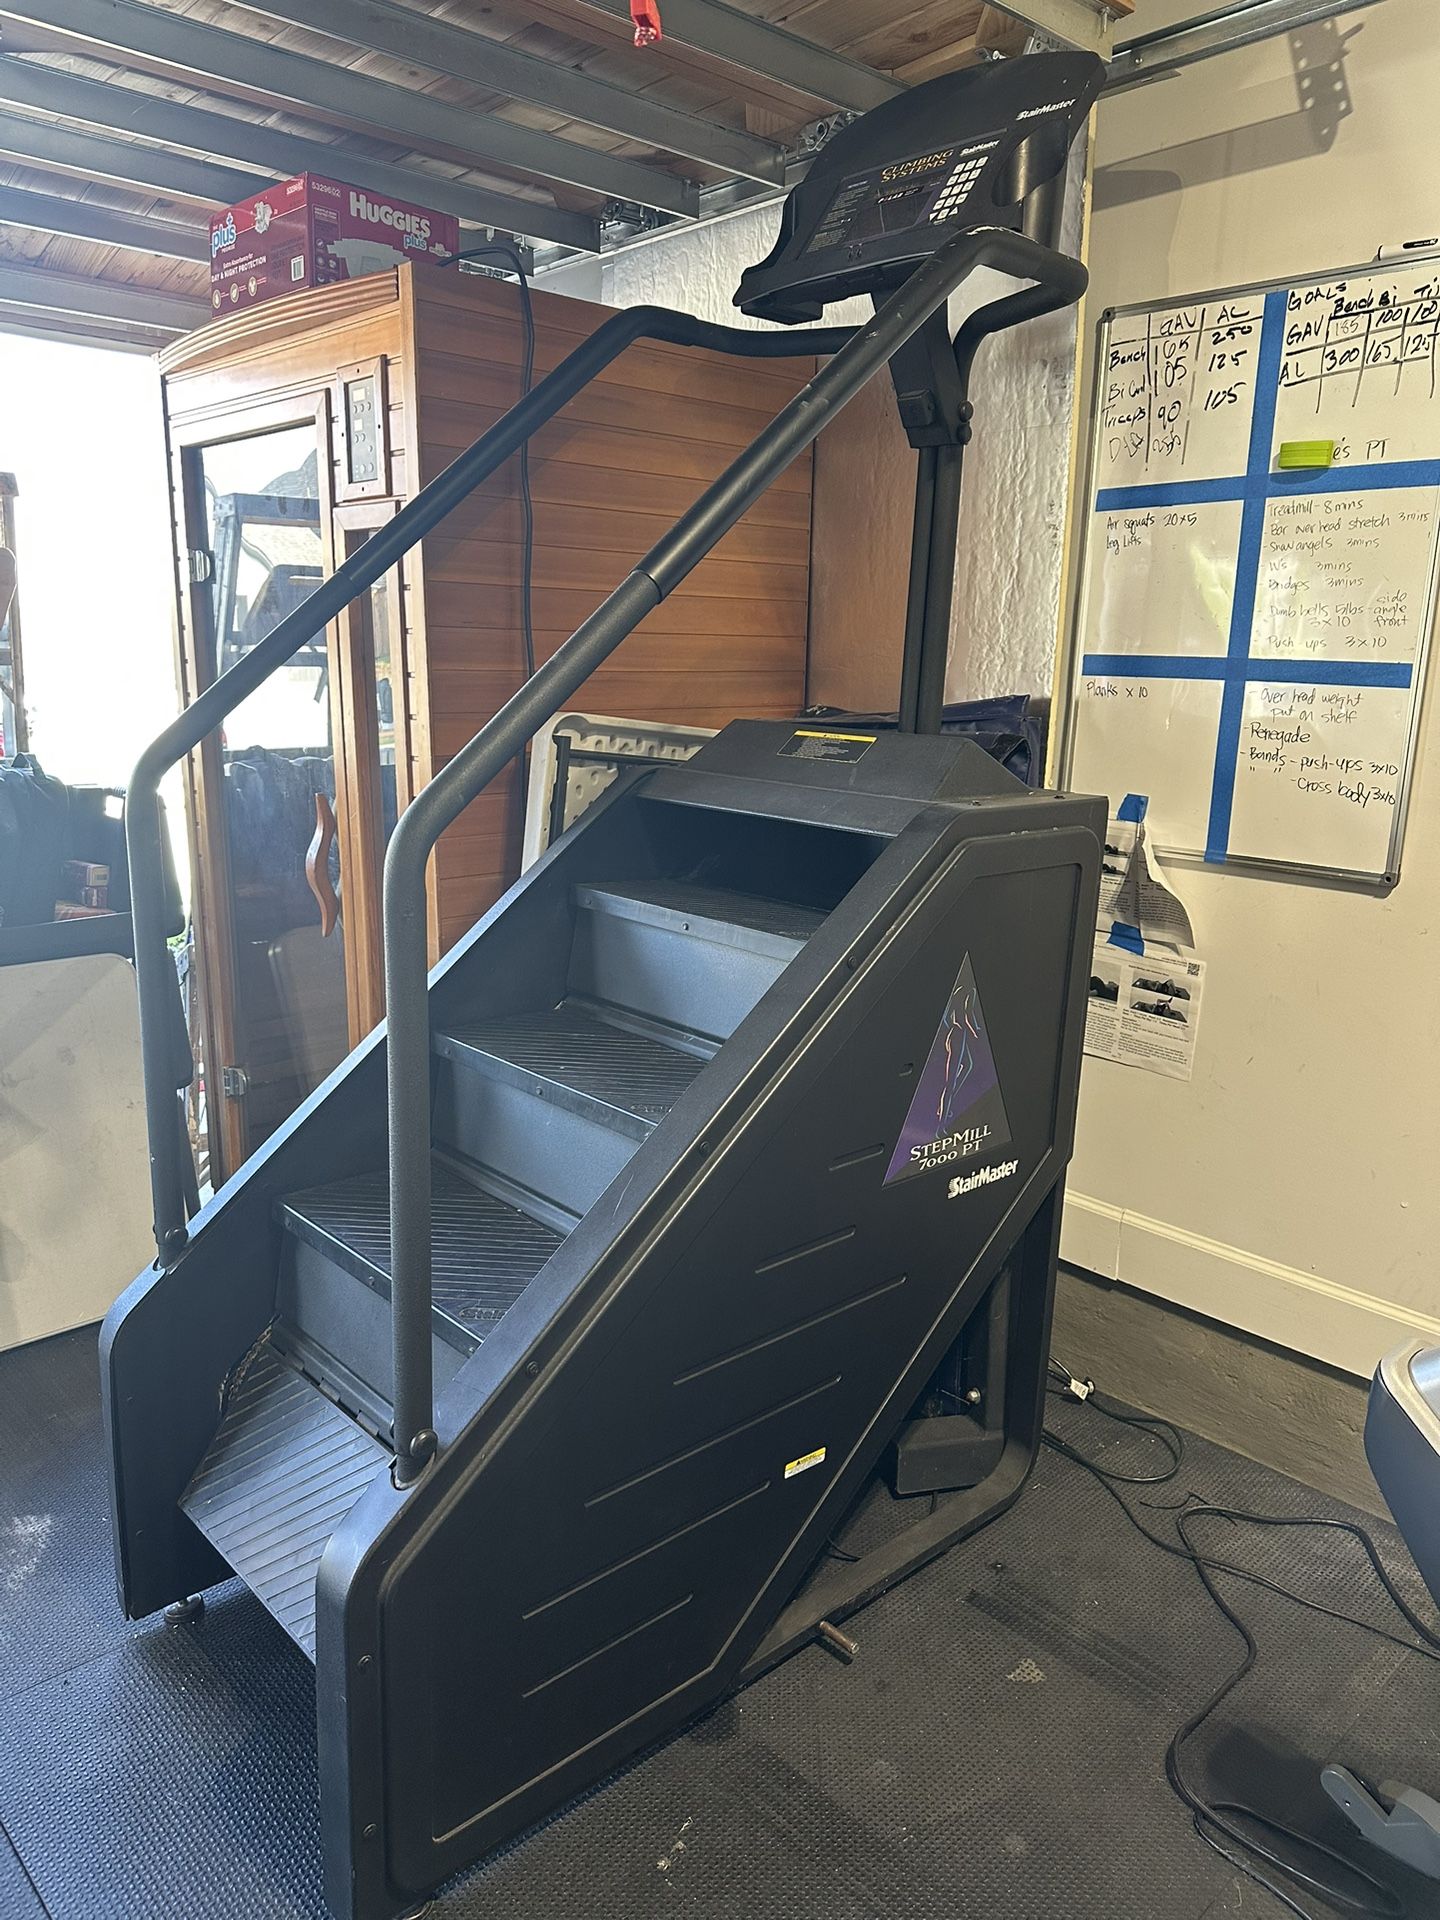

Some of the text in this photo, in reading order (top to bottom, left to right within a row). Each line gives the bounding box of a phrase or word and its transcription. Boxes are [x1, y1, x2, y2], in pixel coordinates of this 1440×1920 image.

[1016, 99, 1076, 121] StairMaster
[881, 158, 947, 183] SYSTEMS
[882, 149, 954, 176] CLIMBING
[212, 219, 236, 258] plus
[404, 234, 427, 251] plus
[239, 255, 267, 273] PROTECTION
[1287, 282, 1347, 311] GOALS
[1379, 285, 1397, 307] Bi
[1287, 314, 1323, 346] GAV
[1376, 308, 1403, 327] 100
[1109, 346, 1147, 372] Bench
[1212, 325, 1253, 346] 250
[1209, 350, 1248, 372] 125
[1325, 348, 1359, 371] 300
[1102, 404, 1146, 428] Triceps
[1157, 400, 1182, 430] 90
[1366, 438, 1390, 460] PT
[1348, 514, 1390, 531] stretch
[1270, 704, 1295, 722] put
[1320, 708, 1358, 724] shelf
[1250, 721, 1311, 749] Renegade
[1249, 747, 1287, 767] Bands
[1297, 777, 1332, 795] Cross
[1337, 780, 1371, 808] body
[910, 1124, 992, 1162] STEPMILL
[918, 1138, 983, 1171] 7000 PT
[947, 1159, 1019, 1200] StairMaster
